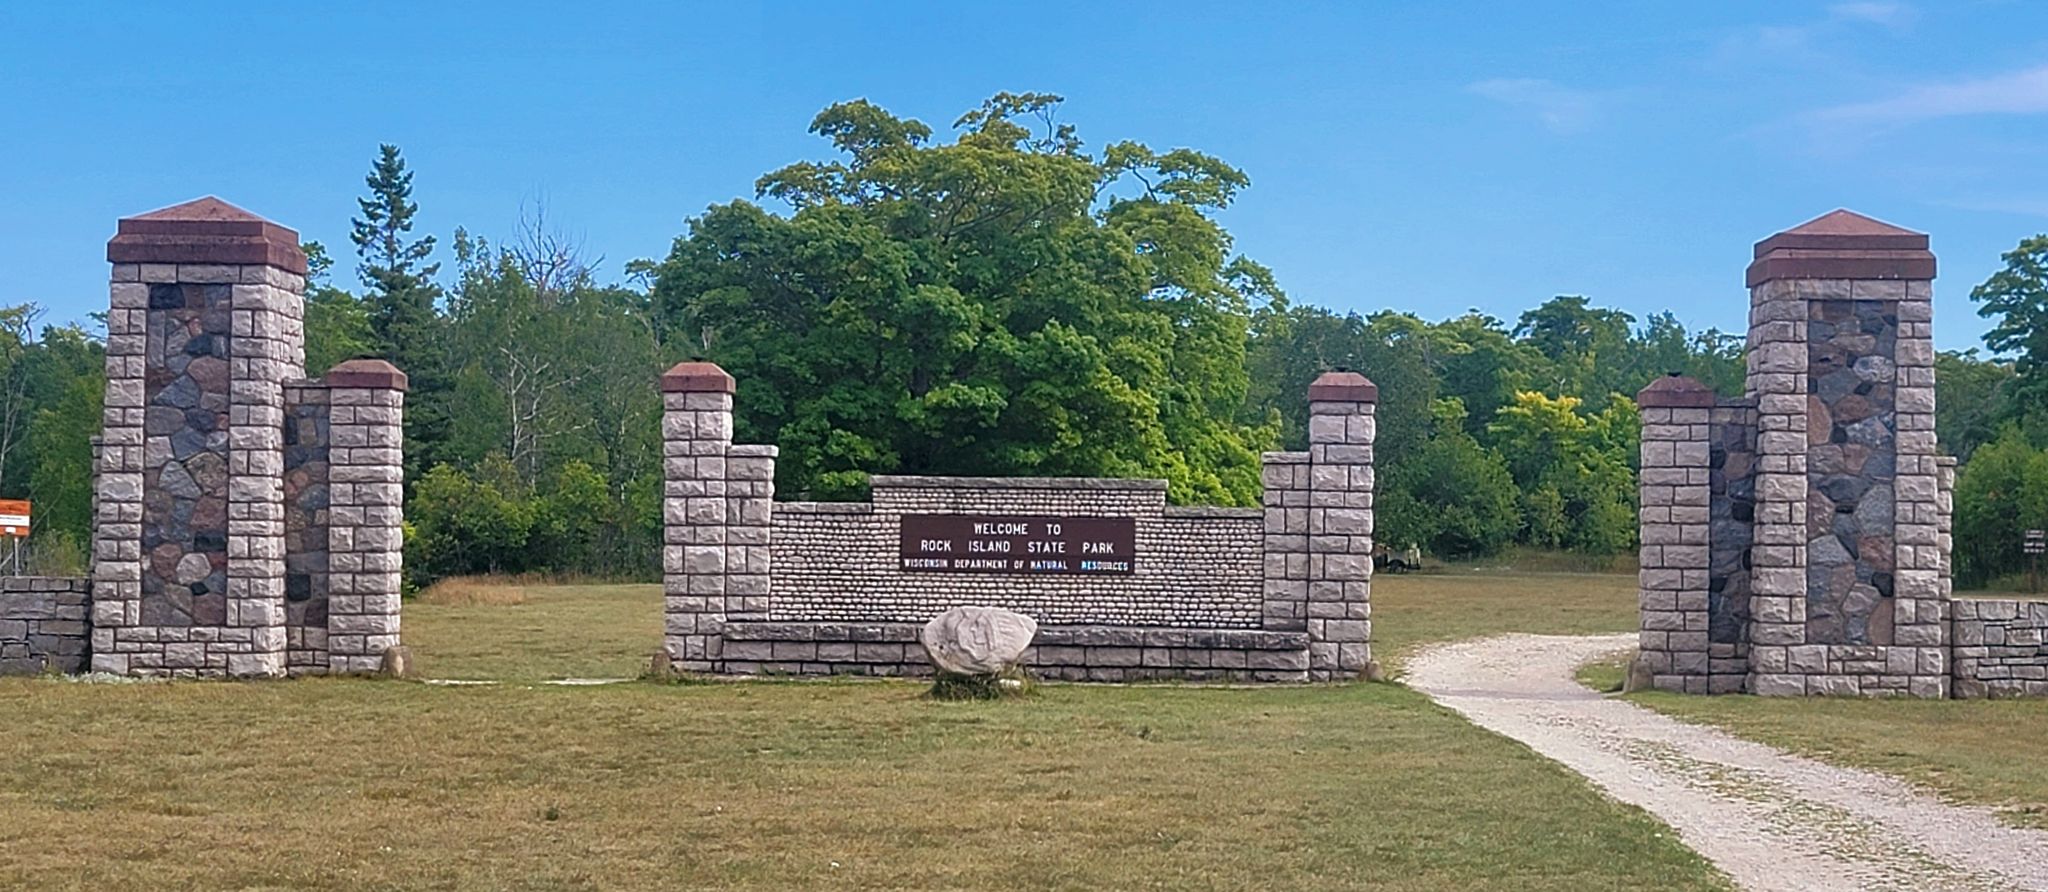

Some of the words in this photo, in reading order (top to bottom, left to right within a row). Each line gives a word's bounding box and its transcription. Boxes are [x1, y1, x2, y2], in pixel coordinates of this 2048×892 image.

[974, 523, 1028, 535] WELCOME
[1046, 523, 1061, 535] TO
[921, 539, 952, 552] ROCK
[968, 540, 1011, 552] ISLAND
[1027, 541, 1066, 553] STATE
[1082, 542, 1114, 554] PARK
[904, 558, 948, 568] WISCONSIN
[954, 559, 1008, 569] DEPARTMENT
[1014, 560, 1024, 569] OF
[1030, 560, 1068, 570] NATURAL
[1081, 560, 1129, 571] RESOURCES
